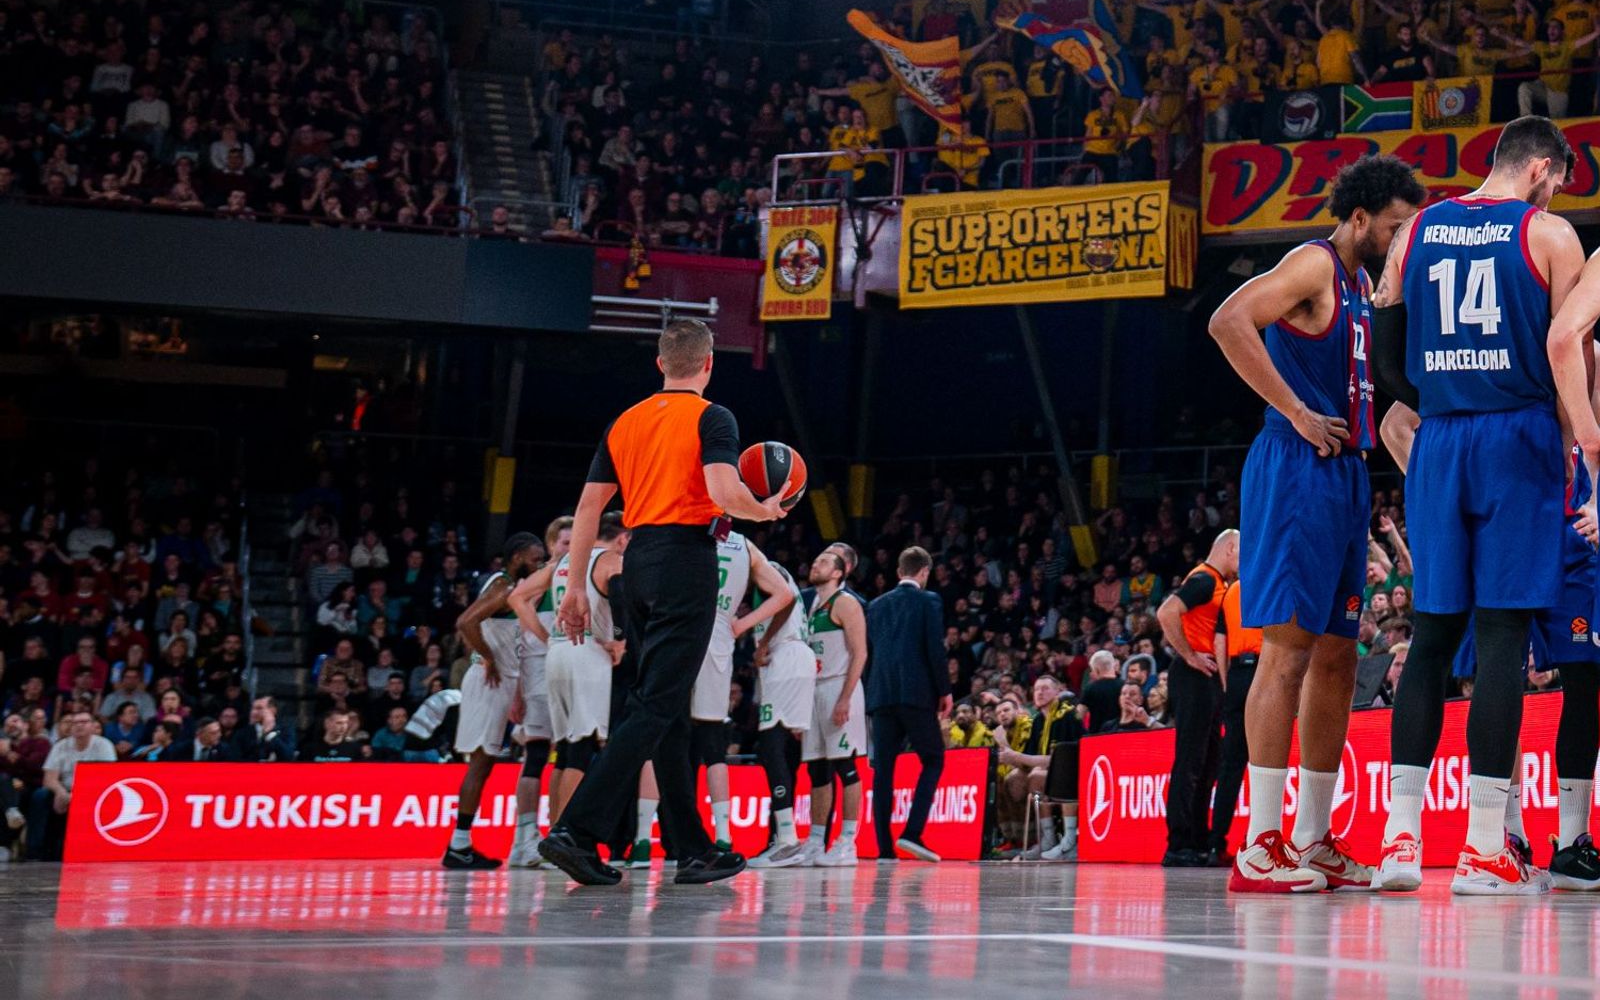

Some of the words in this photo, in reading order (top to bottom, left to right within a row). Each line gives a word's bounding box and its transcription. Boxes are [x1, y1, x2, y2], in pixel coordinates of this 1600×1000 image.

[910, 193, 1163, 259] SUPPORTERS
[1423, 221, 1513, 248] HERNANGÓMEZ
[908, 231, 1164, 293] FCBARCELNA
[1428, 256, 1502, 336] 14
[1424, 348, 1512, 373] BARCELONA
[838, 732, 850, 751] 4
[185, 794, 382, 830] TURKISH
